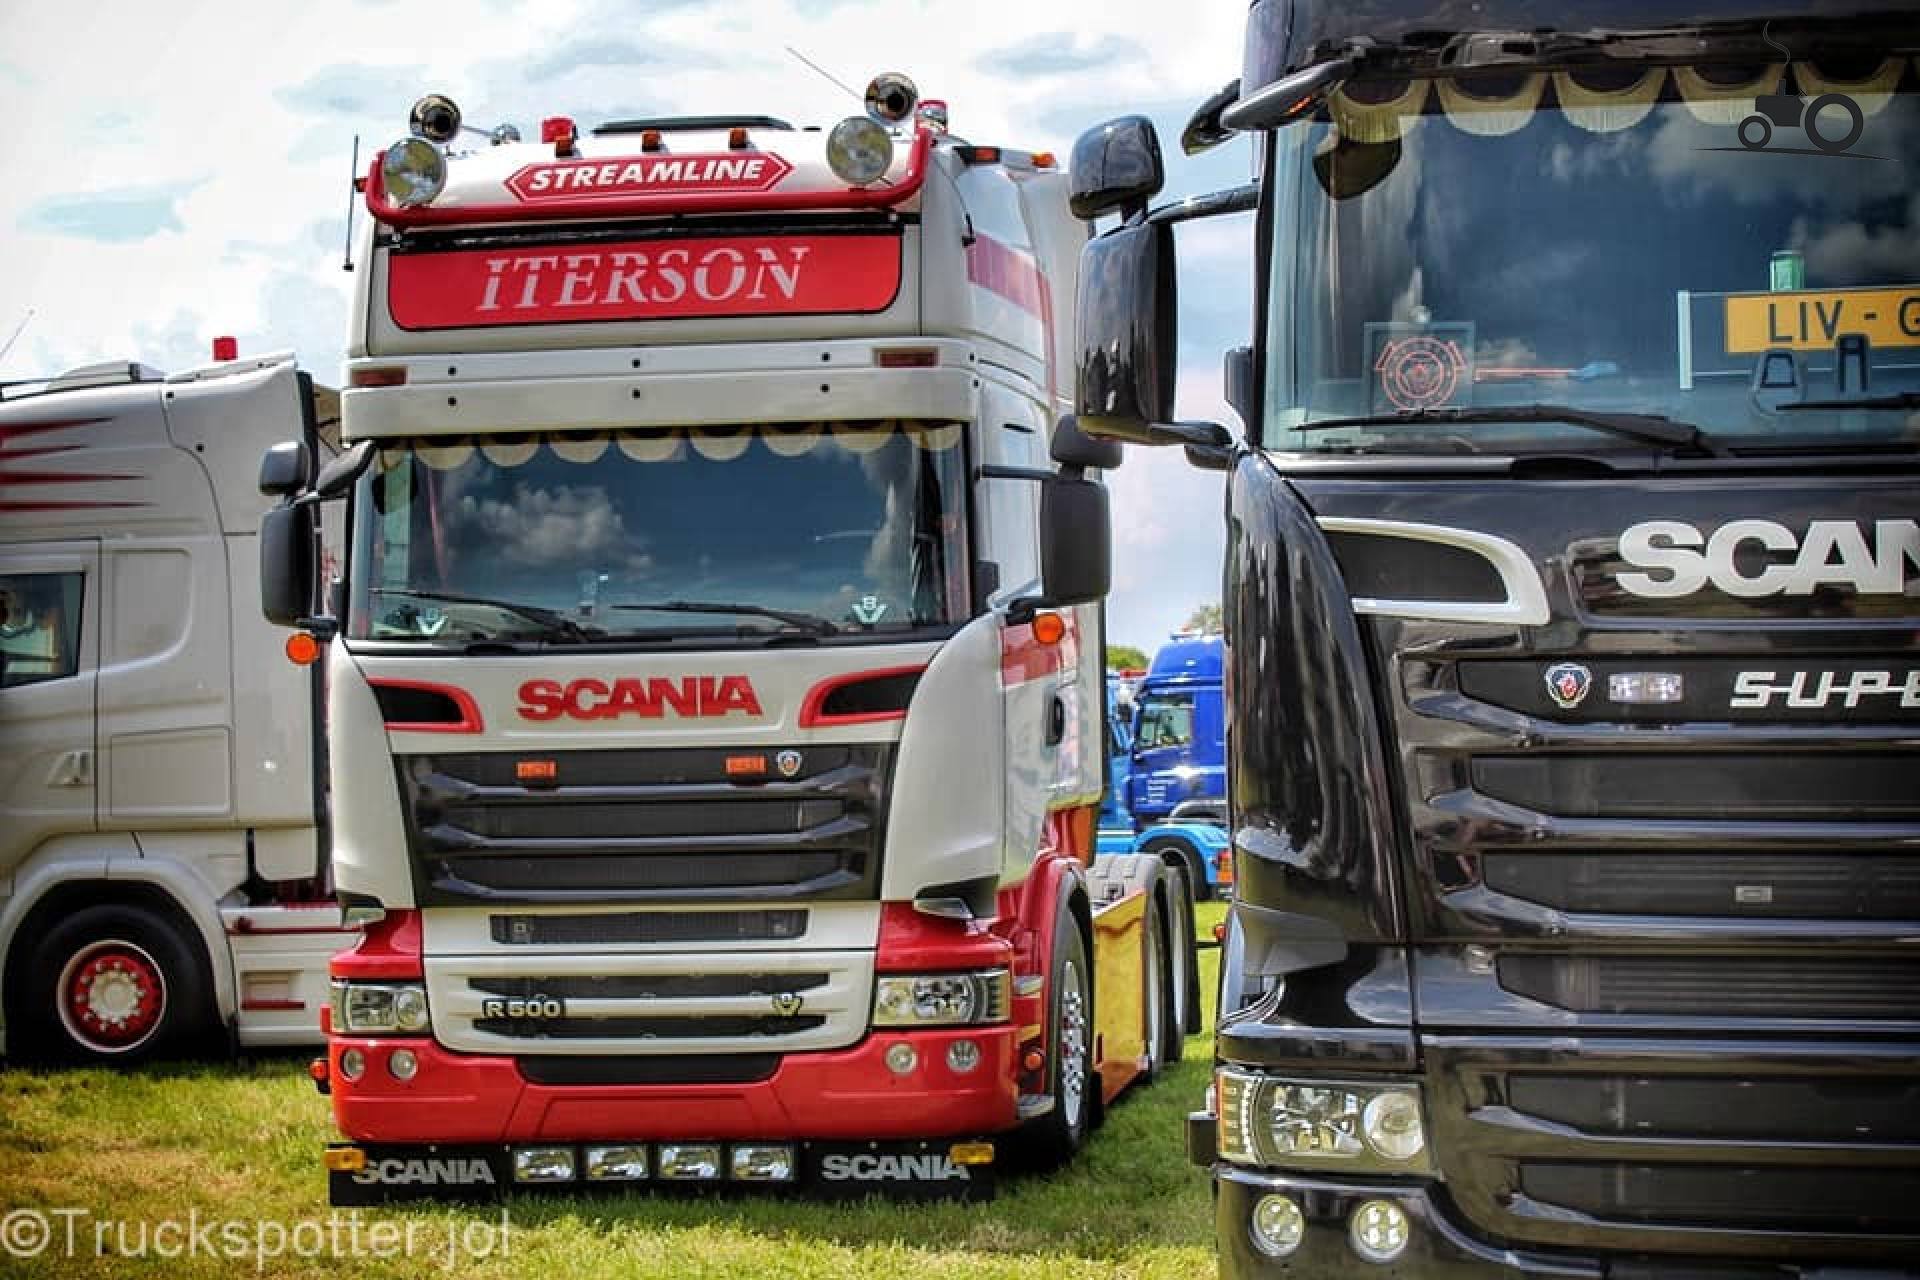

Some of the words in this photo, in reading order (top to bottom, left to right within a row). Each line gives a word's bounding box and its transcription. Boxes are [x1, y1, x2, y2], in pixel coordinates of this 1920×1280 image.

[529, 160, 764, 191] STREAMLINE
[477, 246, 809, 312] ITERSON
[1768, 299, 1844, 343] LIV
[517, 675, 763, 722] SCANIA
[487, 1000, 505, 1018] R
[508, 998, 562, 1018] 500
[352, 1158, 496, 1185] SCANIA
[822, 1154, 970, 1181] SCANIA
